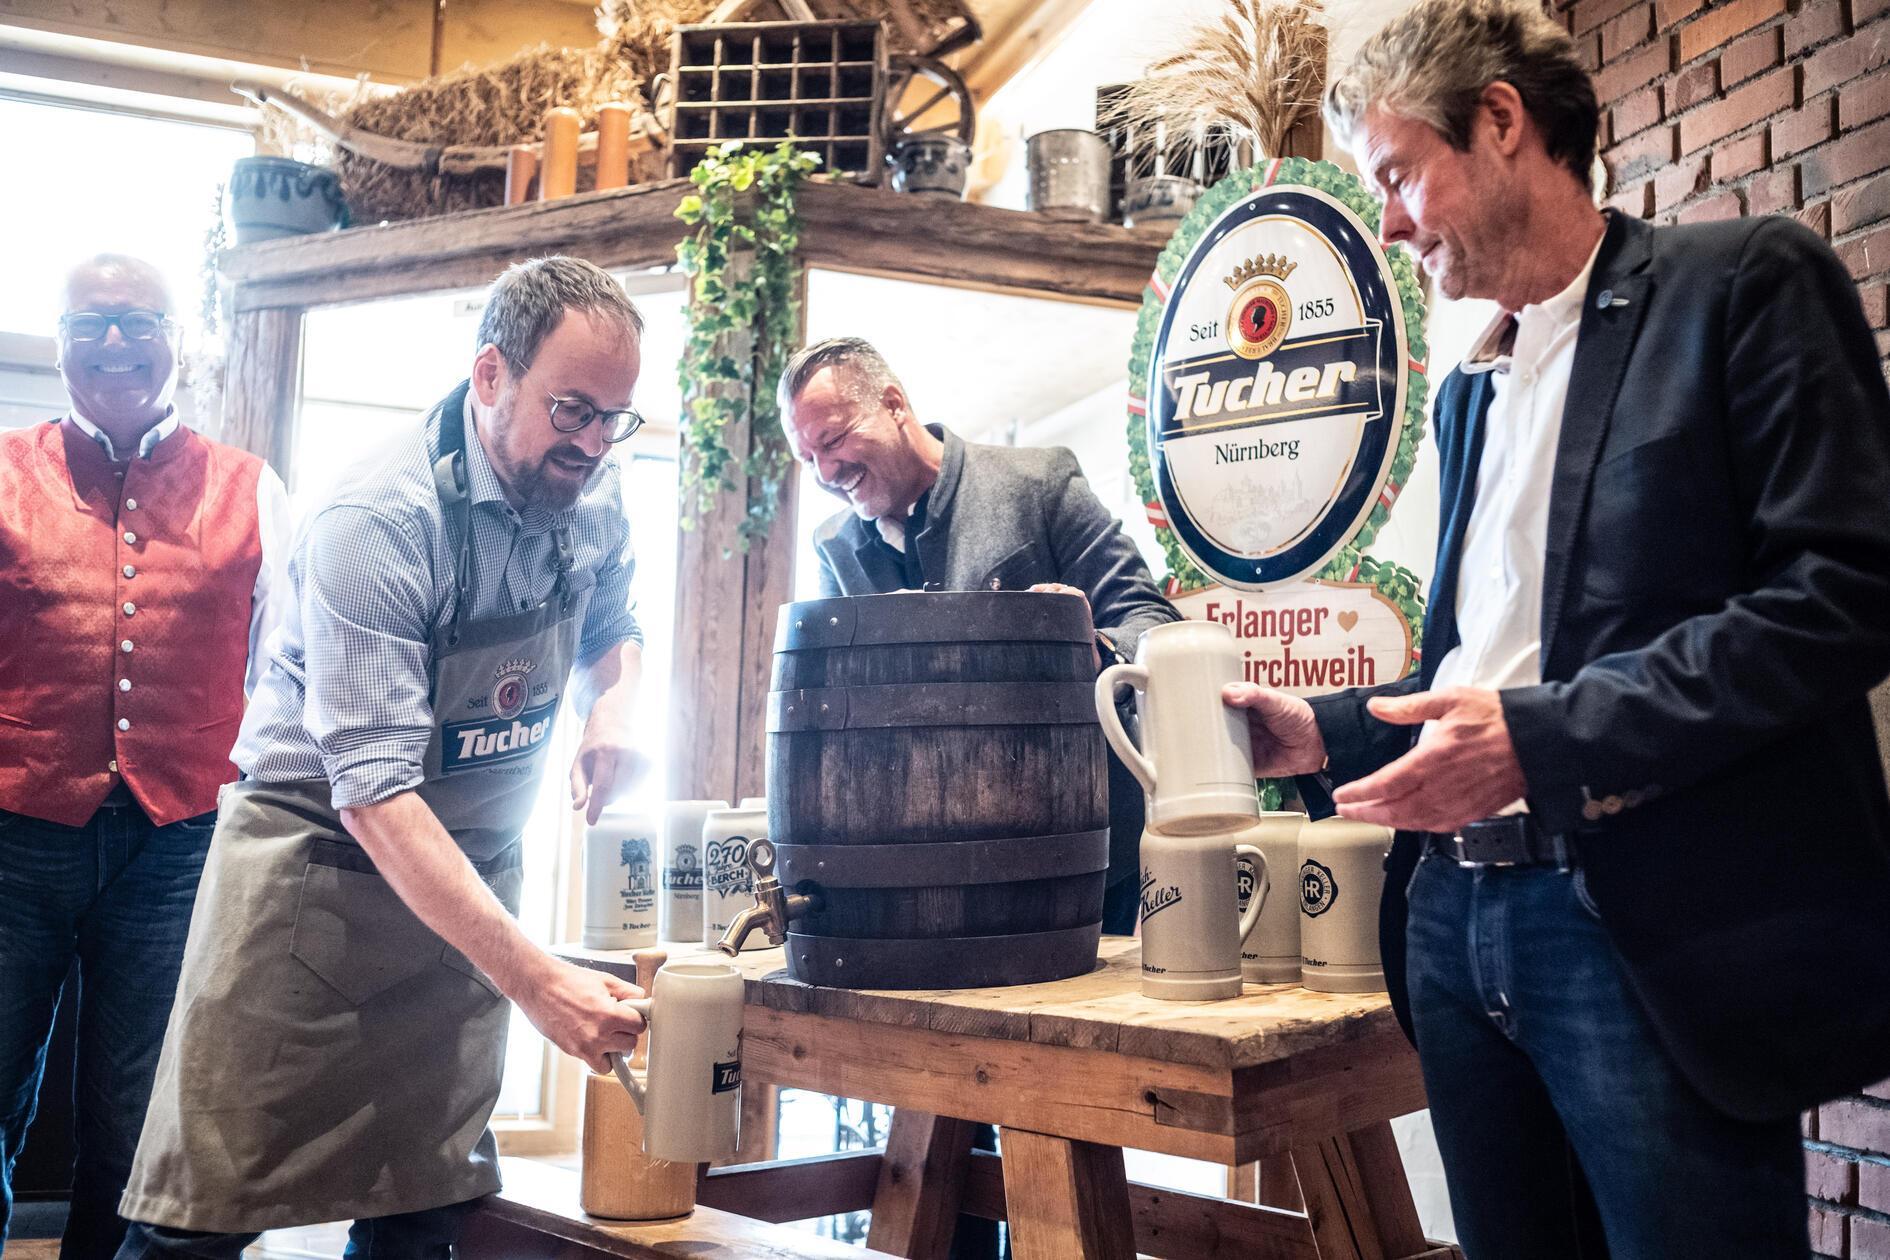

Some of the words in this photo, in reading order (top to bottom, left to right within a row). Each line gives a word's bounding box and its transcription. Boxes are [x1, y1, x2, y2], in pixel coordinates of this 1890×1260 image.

[1189, 320, 1218, 342] Seit
[1297, 298, 1335, 321] 1855
[1172, 360, 1358, 422] Tucher
[1215, 437, 1301, 466] Nürnberg
[1243, 645, 1375, 688] irchweih
[467, 695, 488, 709] Seit
[457, 717, 551, 760] Tucher
[709, 844, 745, 866] 270
[664, 872, 703, 885] Tuche
[711, 869, 744, 885] BERCH
[1304, 880, 1320, 898] HR
[1141, 886, 1182, 918] Keller
